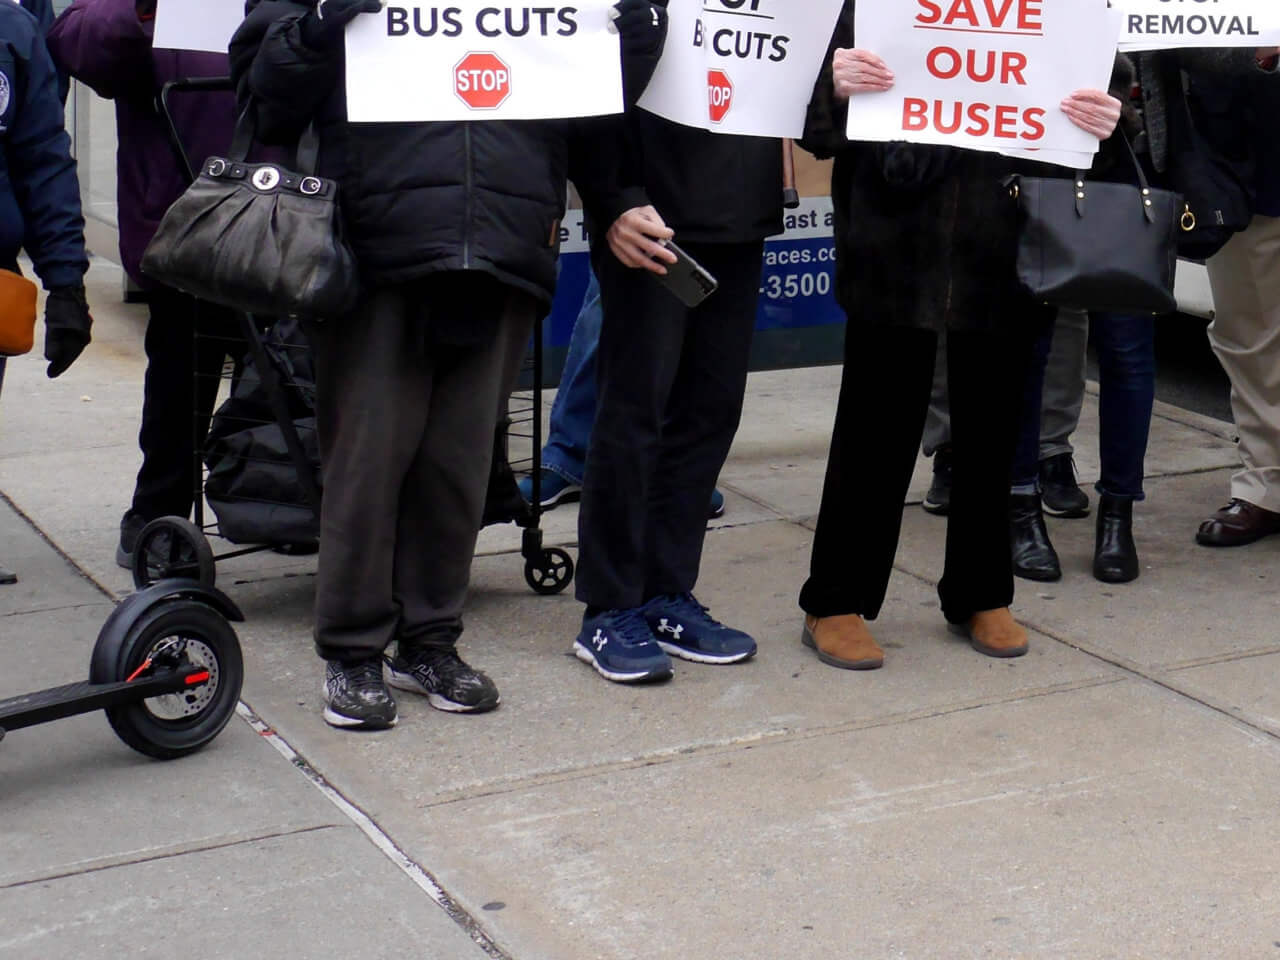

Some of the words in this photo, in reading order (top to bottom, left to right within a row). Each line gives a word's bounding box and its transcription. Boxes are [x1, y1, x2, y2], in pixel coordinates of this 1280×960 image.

[387, 6, 463, 37] BUS
[476, 6, 578, 37] CUTS
[1128, 14, 1260, 36] REMOVAL
[713, 29, 790, 62] CUTS
[926, 46, 1027, 85] OUR
[457, 69, 508, 91] STOP
[708, 85, 731, 106] TOP
[901, 97, 1046, 140] BUSES
[785, 210, 817, 229] ast
[824, 212, 833, 227] a
